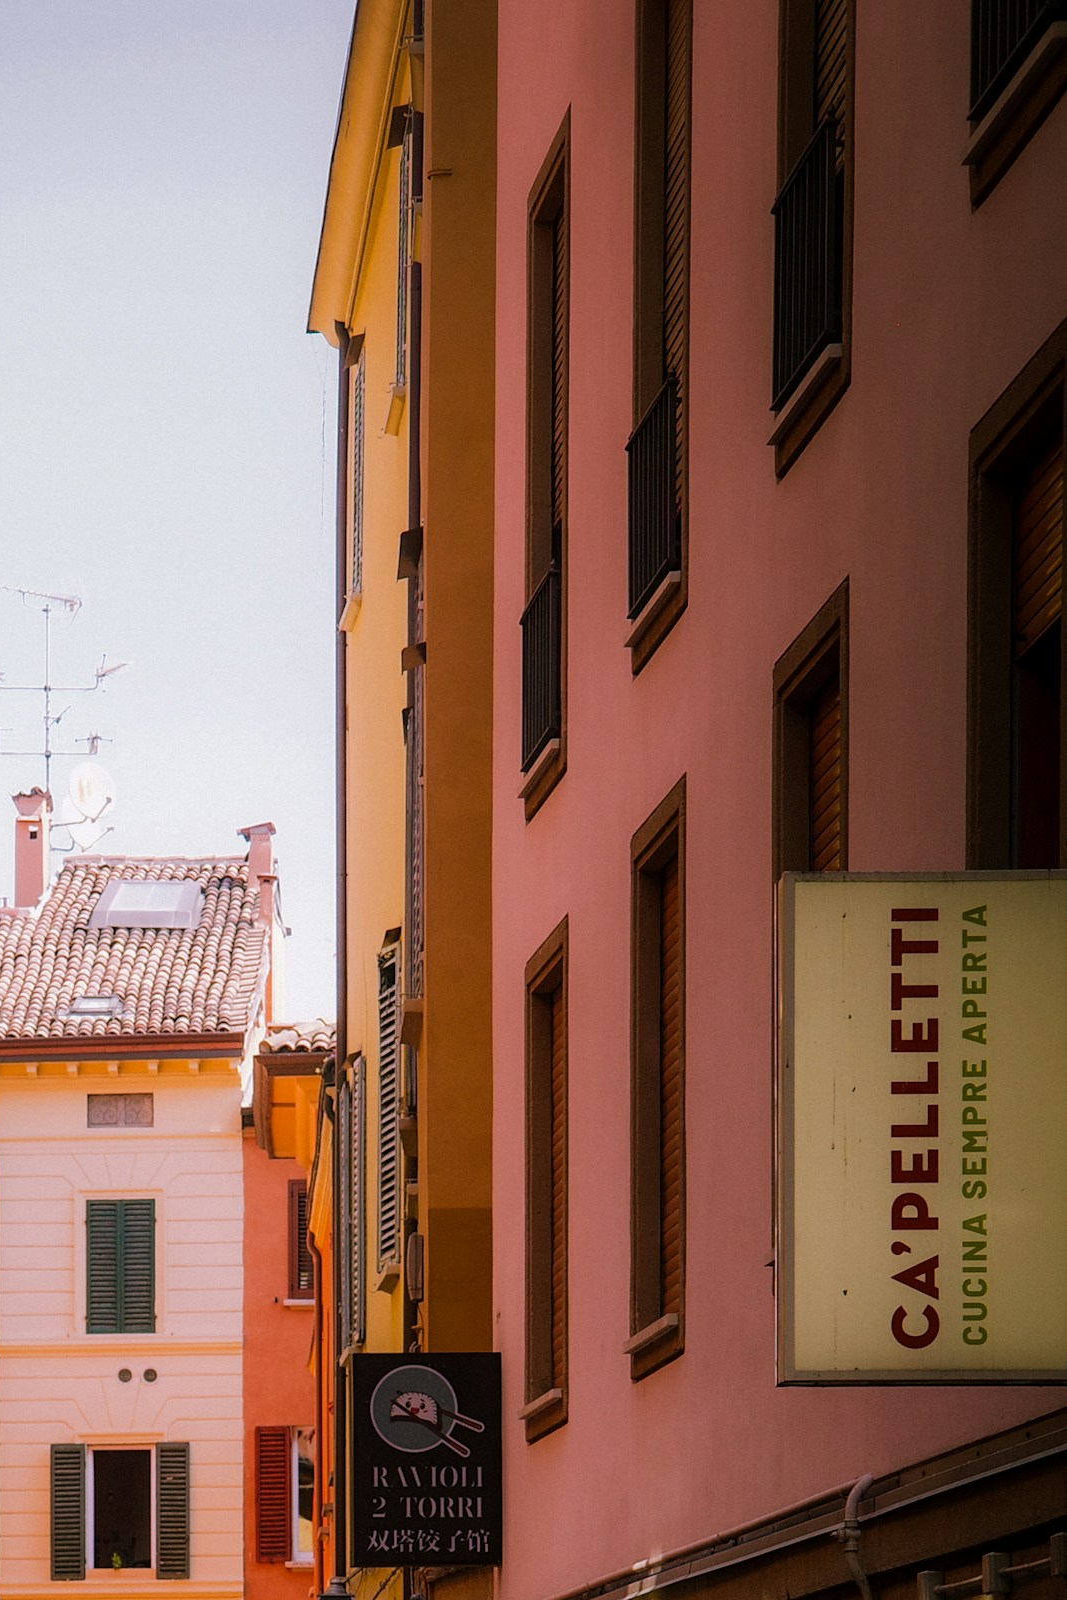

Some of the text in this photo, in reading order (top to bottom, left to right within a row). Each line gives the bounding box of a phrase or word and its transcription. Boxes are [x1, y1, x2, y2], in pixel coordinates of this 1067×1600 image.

[891, 908, 940, 1350] CA'PELLETTI
[962, 904, 988, 1346] CUCINA SEMPRE APERTA
[372, 1465, 484, 1488] RAVIOLI
[372, 1496, 484, 1519] 2 TORRI
[366, 1528, 491, 1553] 双塔饺子馆
